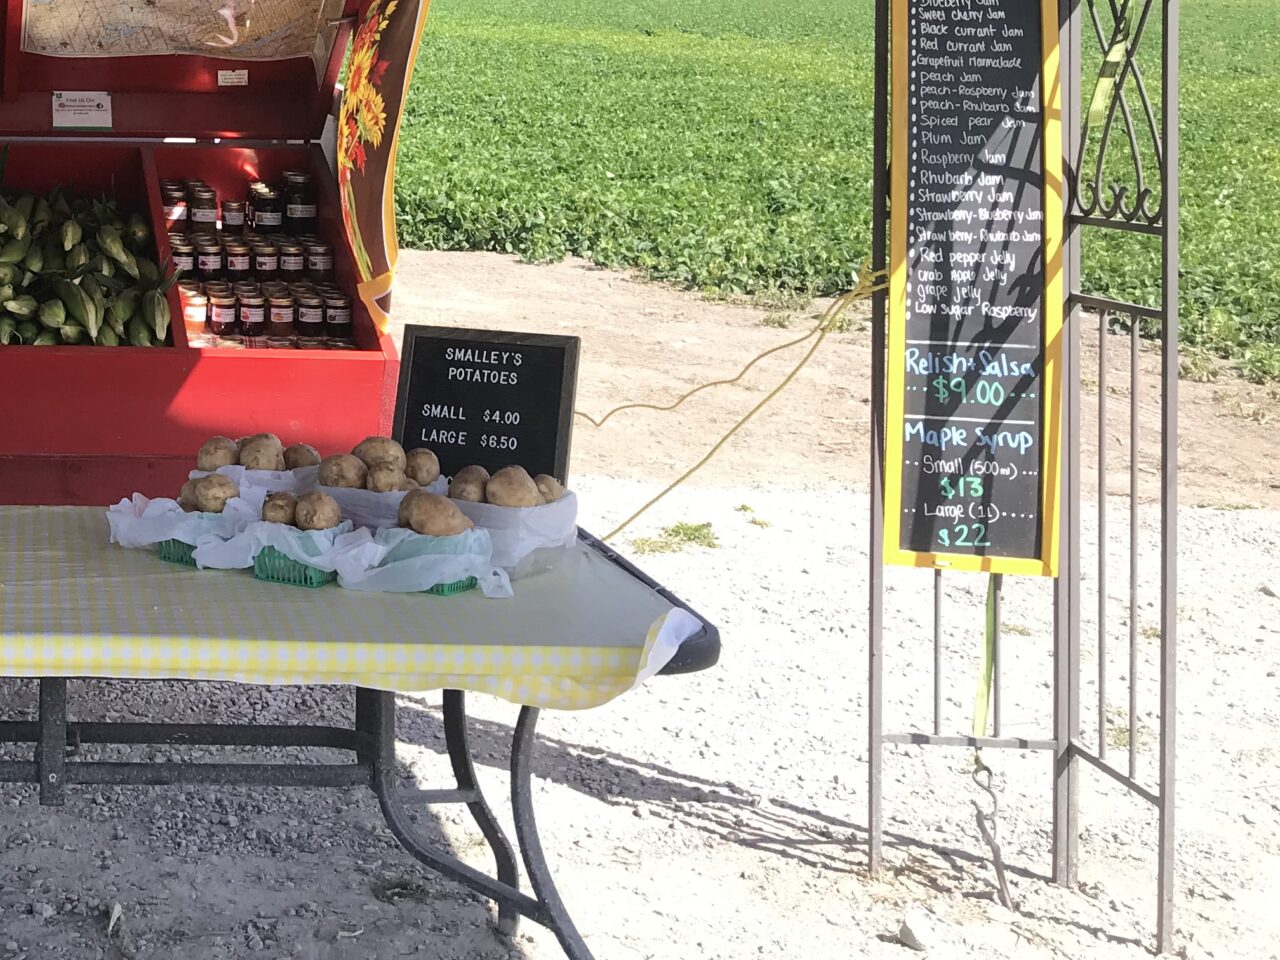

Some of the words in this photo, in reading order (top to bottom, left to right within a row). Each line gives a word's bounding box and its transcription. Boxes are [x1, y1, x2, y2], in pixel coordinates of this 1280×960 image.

[919, 7, 946, 21] Sweet
[986, 8, 1005, 19] Jam
[920, 22, 948, 35] Black
[954, 24, 996, 37] currant
[1002, 24, 1024, 37] Jam
[920, 37, 939, 51] Red
[990, 40, 1012, 52] Jam
[916, 54, 964, 69] Grapefruit
[969, 57, 1022, 69] Marmalade
[960, 72, 982, 82] Jam
[1011, 86, 1035, 99] Jam
[1014, 101, 1036, 112] Jam
[920, 115, 958, 126] Spiced
[968, 117, 993, 130] pear
[1002, 115, 1025, 127] Jam
[921, 131, 951, 144] Plum
[959, 132, 987, 145] Jam
[920, 149, 974, 168] Raspberry
[982, 149, 1006, 164] Jam
[920, 170, 973, 185] Rhubarb
[978, 172, 1004, 186] Jam
[918, 189, 983, 206] Strawberry
[987, 188, 1014, 203] Jam
[1025, 207, 1043, 221] Jam
[1022, 230, 1041, 241] Jam
[920, 247, 943, 262] Red
[949, 252, 986, 267] pepper
[990, 249, 1015, 272] Jelly
[983, 266, 1007, 286] Jelly
[917, 284, 948, 303] grape
[915, 301, 937, 314] Low
[982, 303, 1037, 323] Raspberry
[445, 348, 522, 366] SMALLEY'S
[905, 348, 967, 375] Relish
[978, 349, 1035, 377] Salsa
[448, 368, 518, 385] POTATOES
[932, 375, 1005, 405] $9.00
[422, 403, 466, 420] SMALL
[483, 409, 520, 425] $4.00
[422, 428, 467, 445] LARGE
[480, 434, 517, 450] $6.50
[904, 421, 967, 450] Maple
[974, 427, 1033, 455] Syrup
[923, 455, 964, 474] Small
[940, 477, 983, 499] $13
[924, 503, 965, 524] Large
[938, 524, 991, 546] $22
